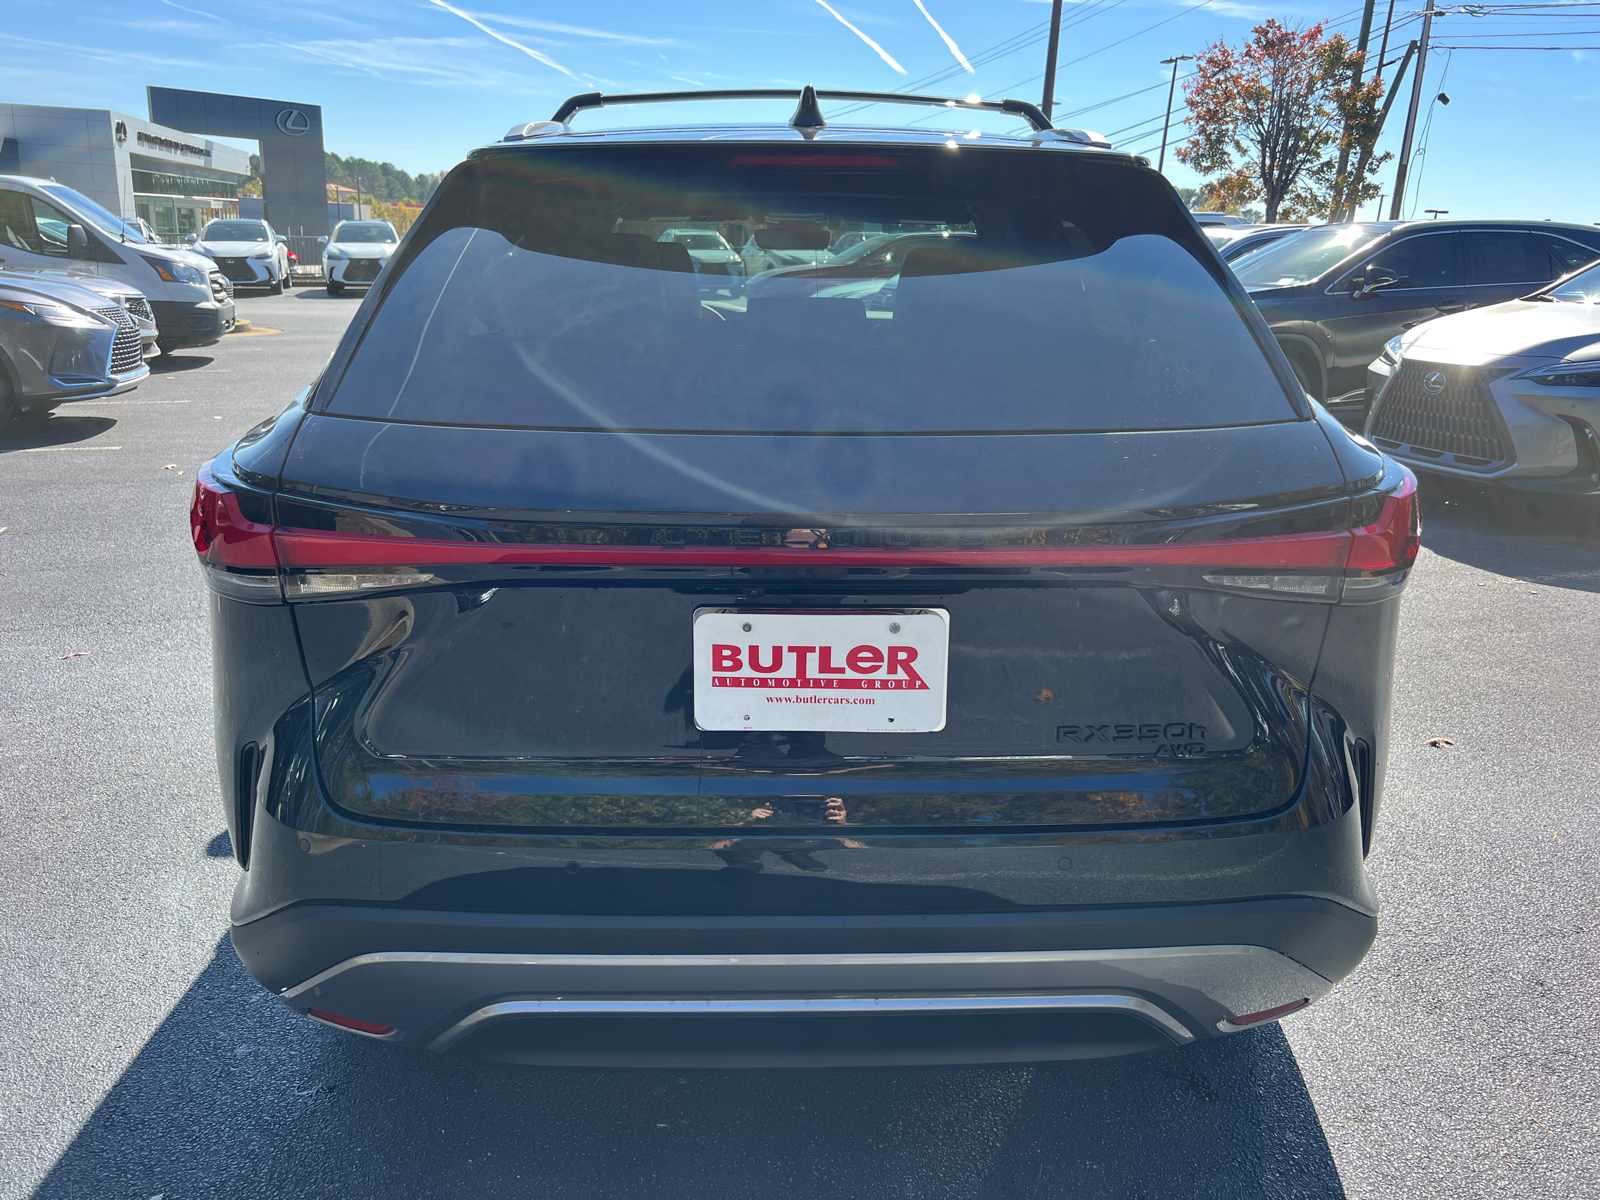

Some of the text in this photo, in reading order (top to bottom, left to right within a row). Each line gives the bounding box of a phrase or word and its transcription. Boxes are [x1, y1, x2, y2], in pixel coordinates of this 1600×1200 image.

[660, 528, 985, 548] LEXUS
[713, 678, 922, 689] AUTOMOTIVE GROUP
[766, 695, 875, 705] www.butlercars.com
[1154, 742, 1207, 758] AWD
